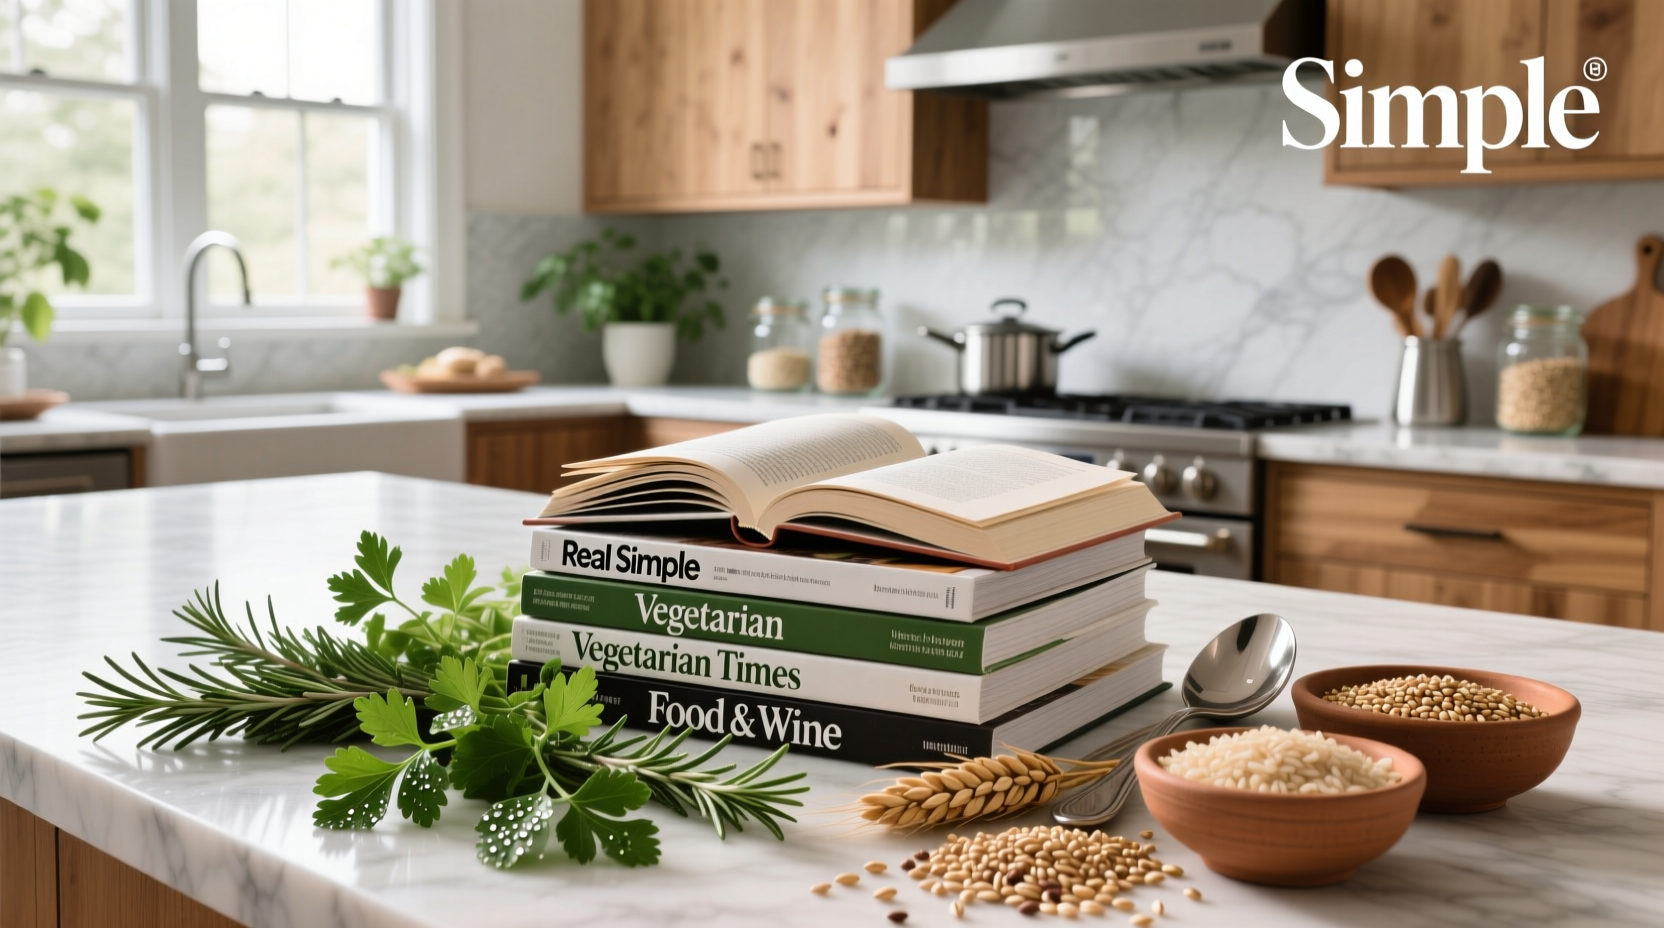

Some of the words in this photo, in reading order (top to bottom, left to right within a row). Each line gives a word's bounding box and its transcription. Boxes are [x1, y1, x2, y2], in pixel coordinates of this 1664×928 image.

[562, 539, 612, 571] Real
[615, 544, 701, 583] Simple
[634, 592, 785, 640] Vegetarian
[571, 630, 711, 678] Vegetarian
[717, 649, 801, 690] Times
[647, 690, 725, 735] Food
[730, 703, 756, 738] &
[757, 704, 842, 750] Wine
